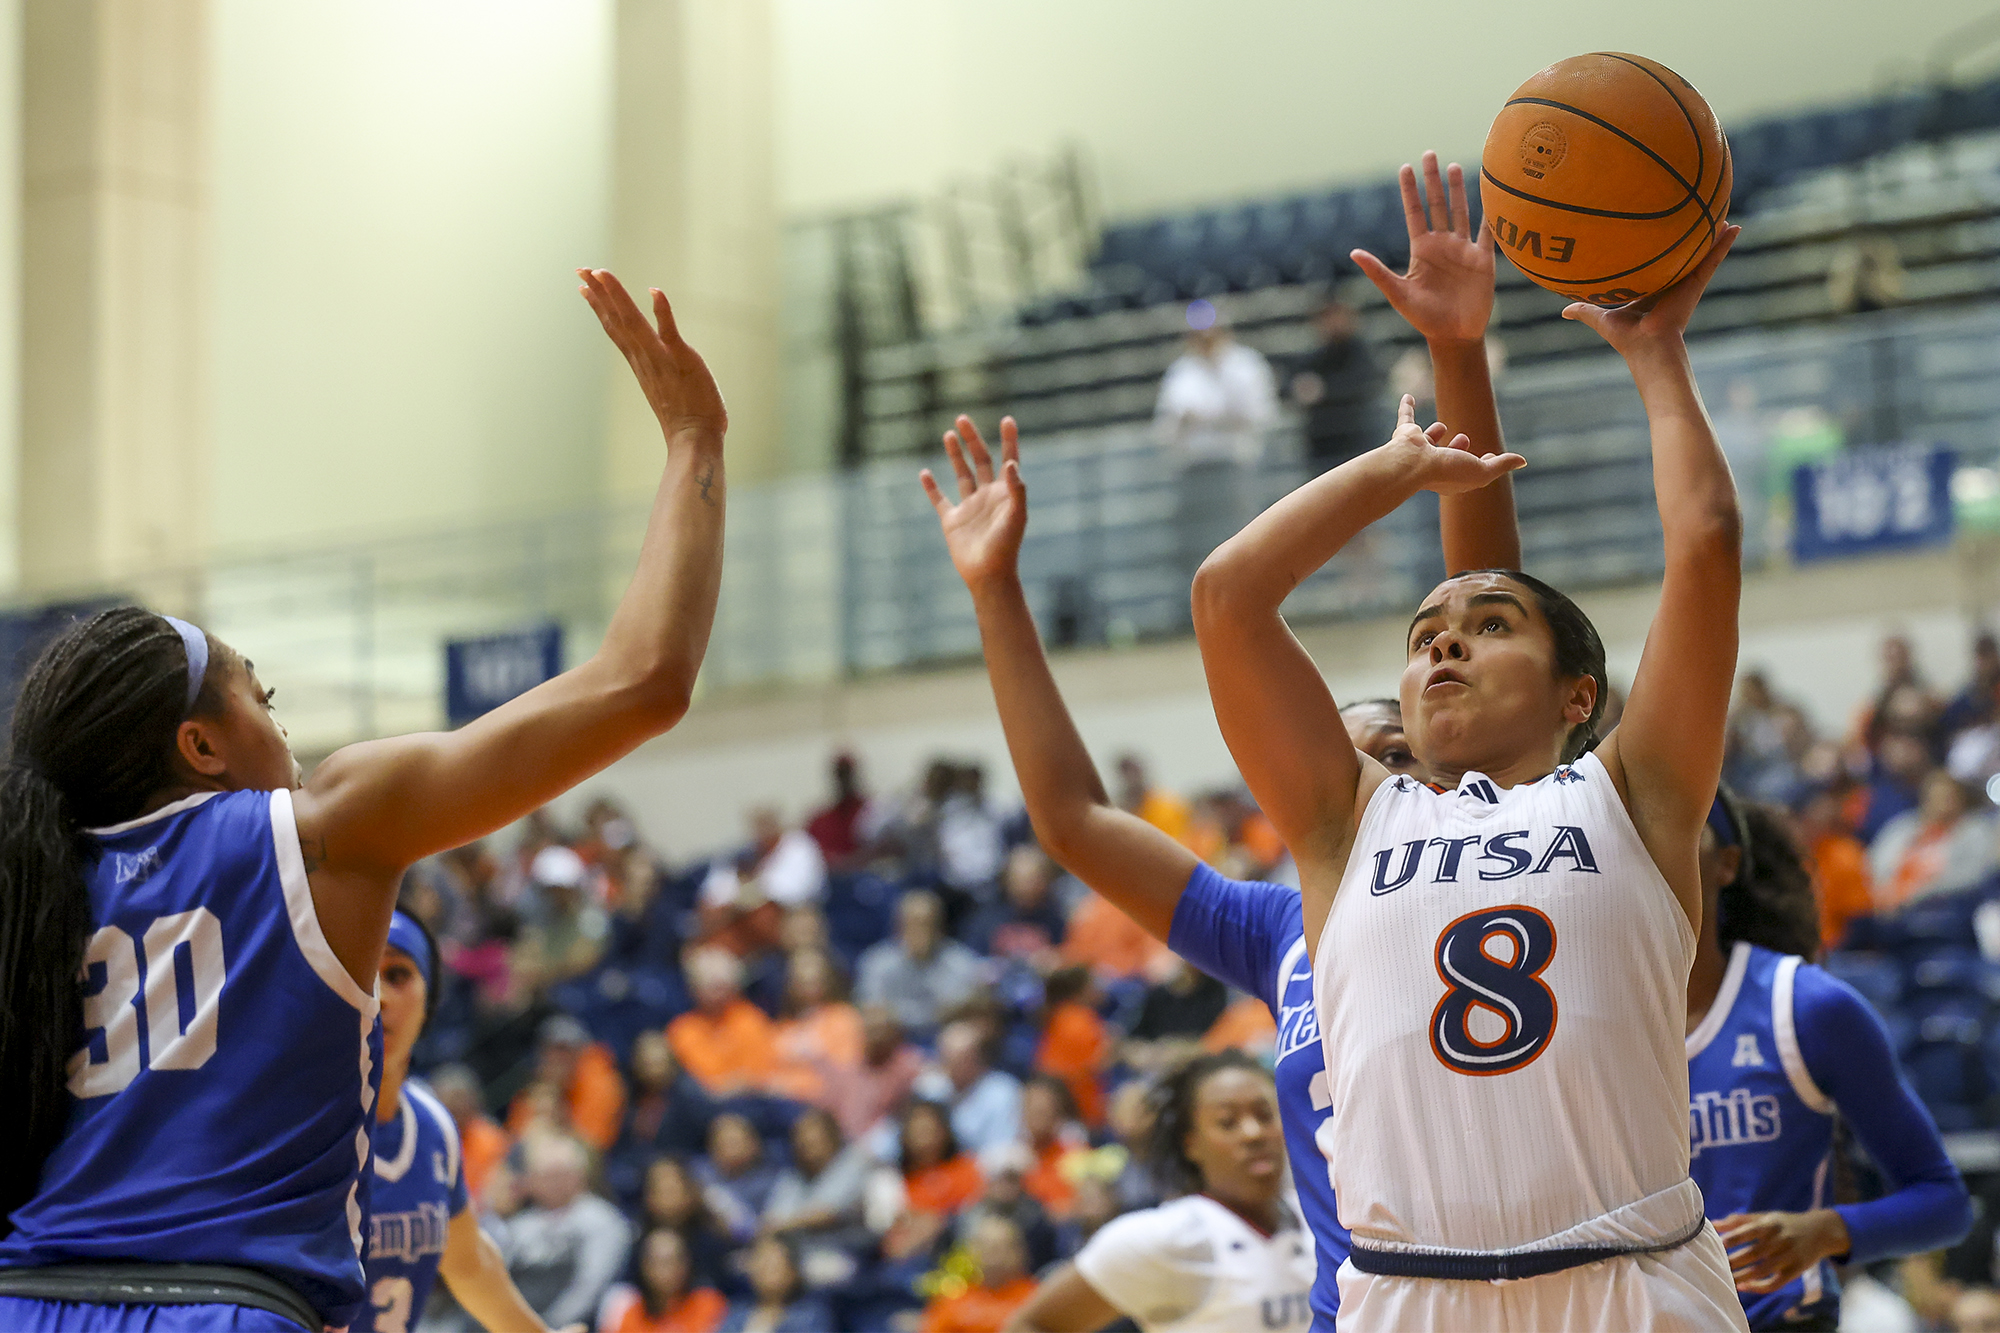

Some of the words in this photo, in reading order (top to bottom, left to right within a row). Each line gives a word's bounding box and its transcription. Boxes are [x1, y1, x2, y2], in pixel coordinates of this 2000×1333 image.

[1495, 215, 1577, 263] EVO
[1370, 825, 1602, 897] UTSA
[67, 904, 227, 1100] 30
[1428, 903, 1559, 1077] 8
[1731, 1033, 1765, 1068] A
